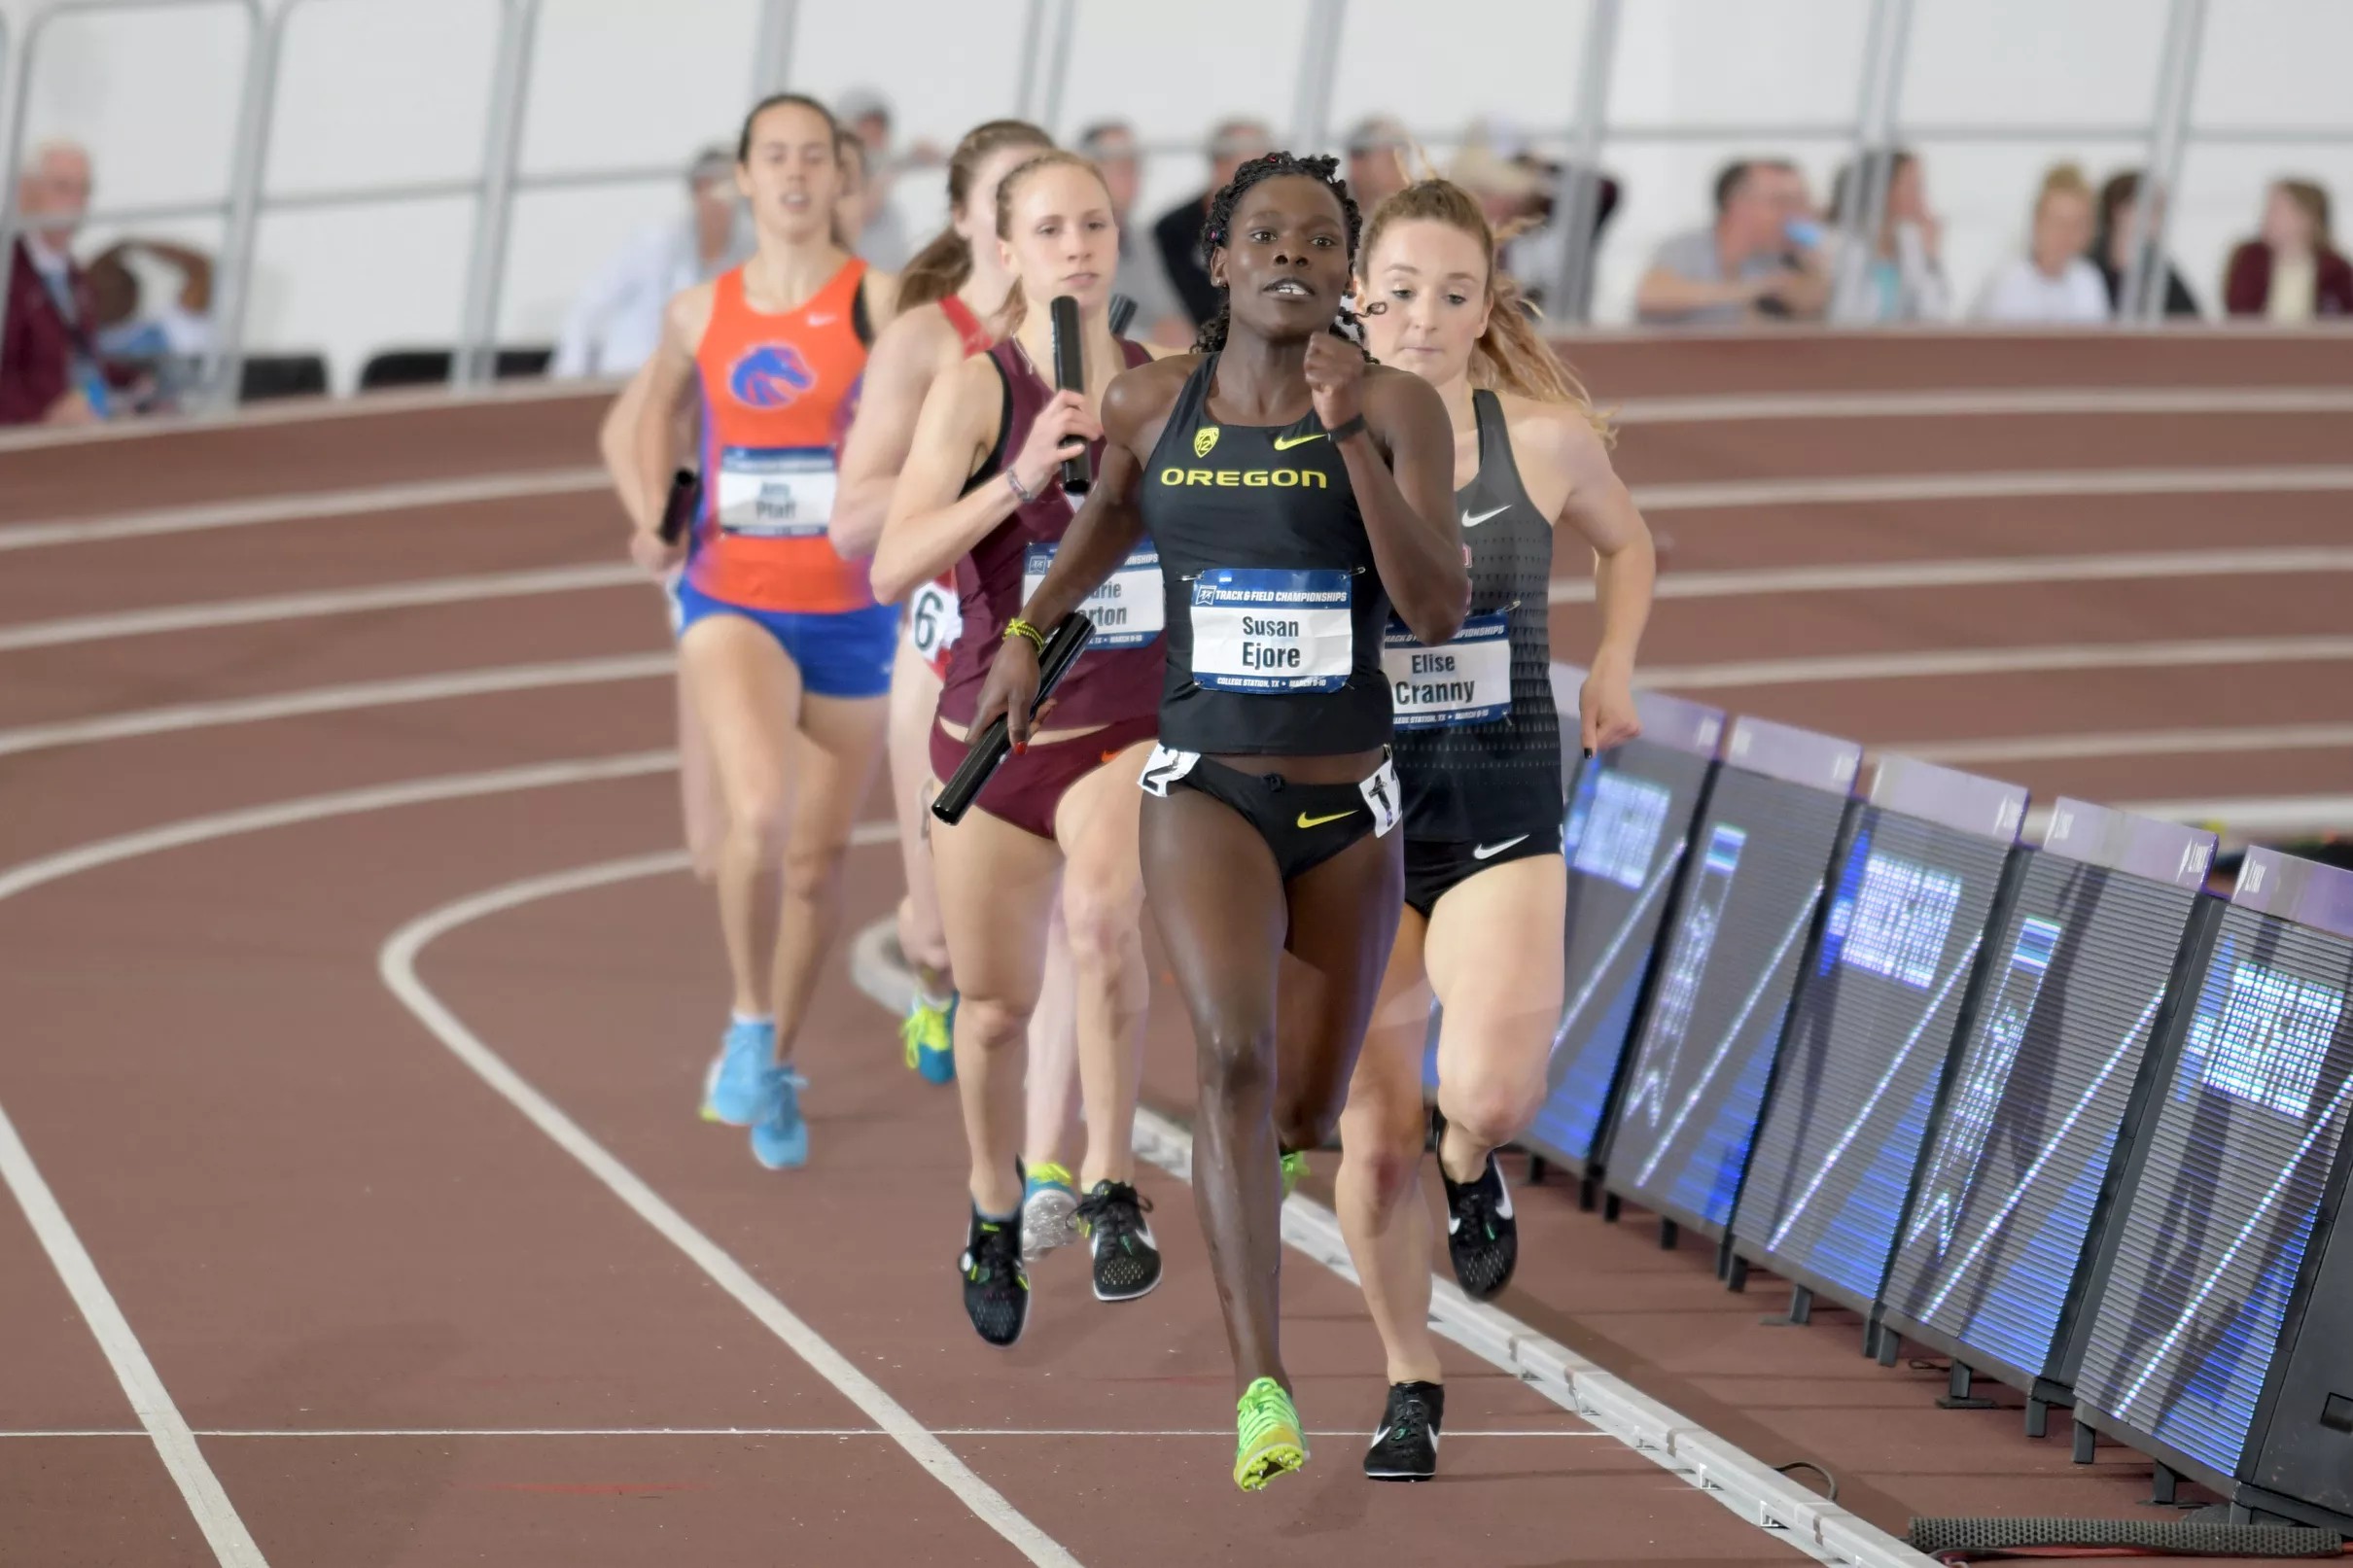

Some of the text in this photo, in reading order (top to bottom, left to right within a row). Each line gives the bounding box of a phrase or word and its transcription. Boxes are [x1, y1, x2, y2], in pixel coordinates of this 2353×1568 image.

[1161, 469, 1327, 489] OREGON
[1215, 590, 1244, 601] TRACK
[1251, 591, 1275, 602] FIELD
[1276, 591, 1348, 603] CHAMPIONSHIPS
[915, 590, 944, 652] 6
[1243, 616, 1299, 637] Susan
[1243, 642, 1301, 670] Ejore
[1412, 654, 1456, 674] Elise
[1396, 680, 1476, 705] Cranny
